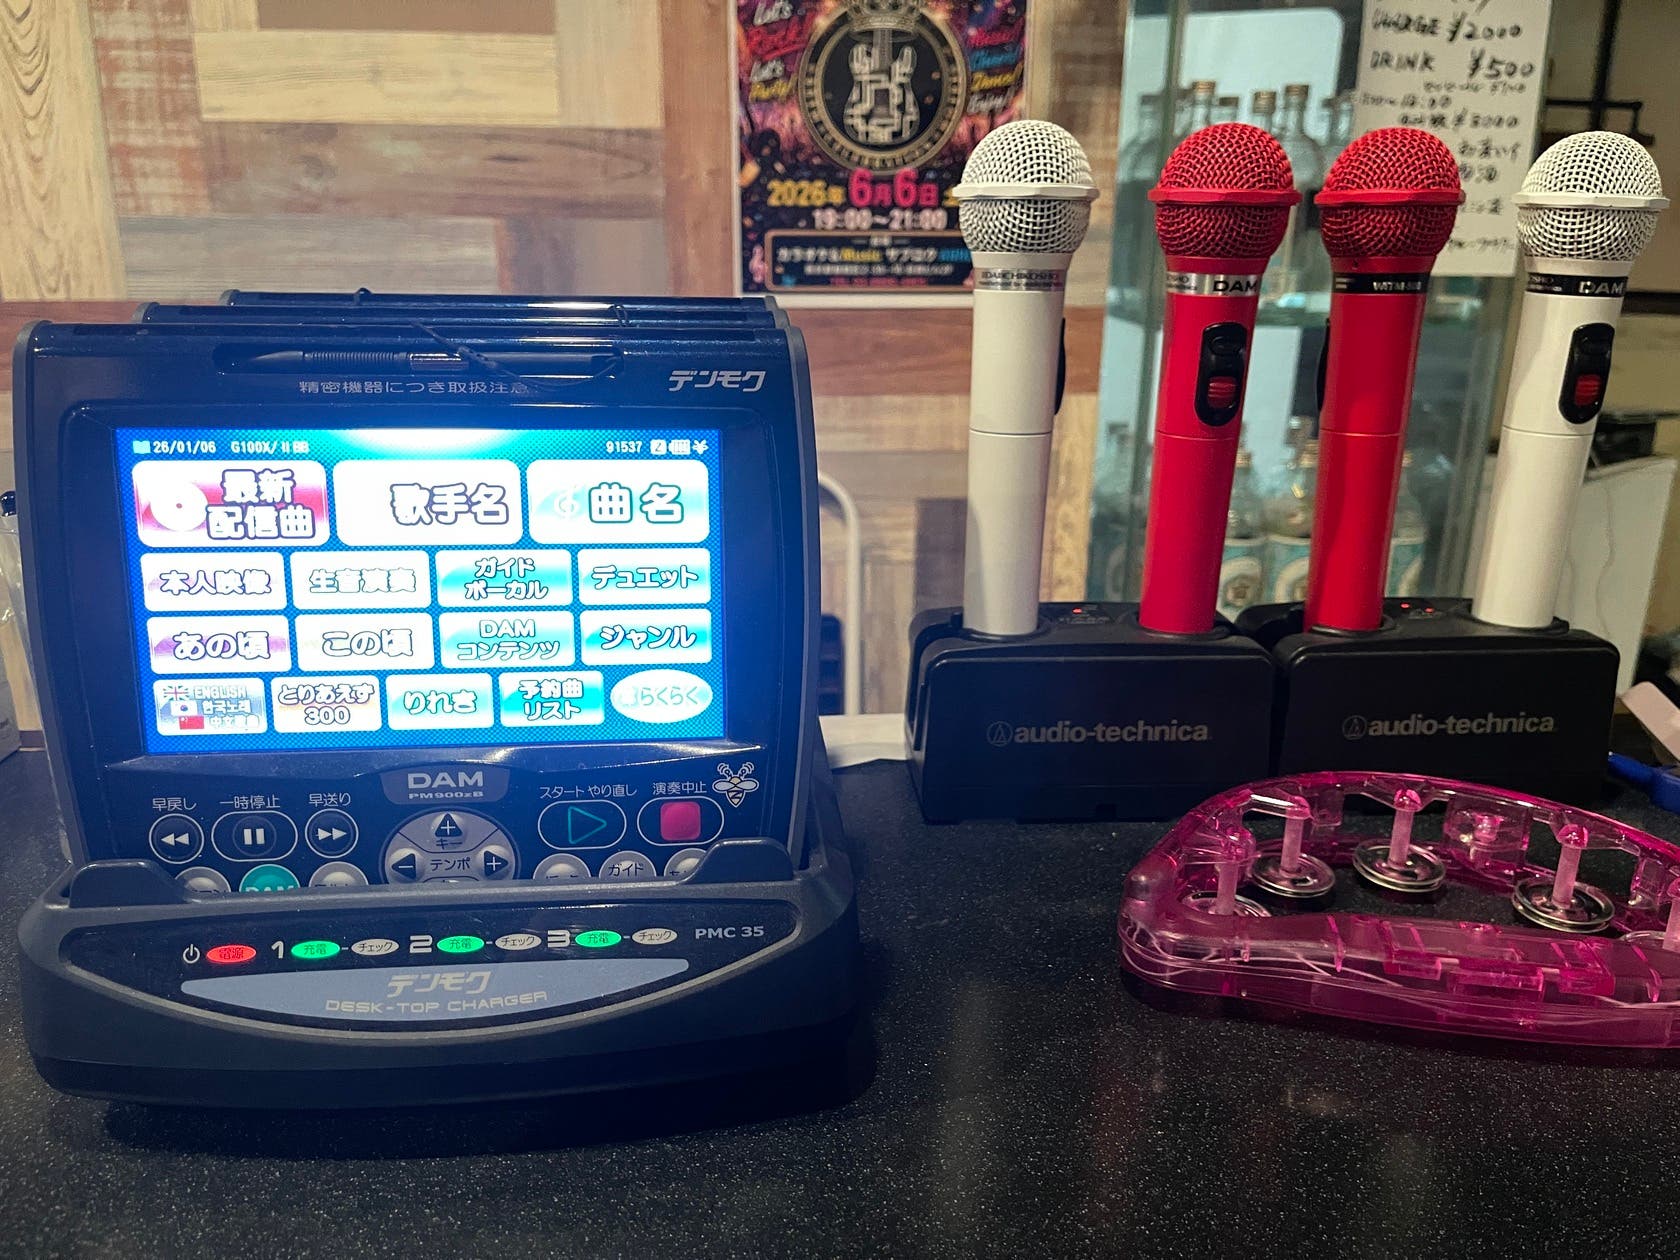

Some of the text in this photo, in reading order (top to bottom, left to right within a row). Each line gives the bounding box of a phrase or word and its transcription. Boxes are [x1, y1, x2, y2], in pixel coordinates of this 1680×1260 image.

[1213, 280, 1257, 292] DAM
[1579, 281, 1624, 294] DAM
[668, 369, 766, 393] デンモク
[153, 440, 217, 454] 26/01/06
[605, 440, 643, 453] 91537
[220, 468, 296, 504] 最新
[205, 503, 316, 540] 配信曲
[474, 556, 535, 579] ガイド
[591, 564, 699, 590] デュエット
[464, 579, 549, 601] ボーカル
[479, 619, 536, 638] DAM
[599, 624, 697, 651] ジャンル
[172, 632, 271, 661] あの頃
[321, 628, 414, 657] この頃
[457, 641, 560, 661] コンテンツ
[193, 685, 248, 700] ENGLISH
[517, 678, 584, 699] 予約曲
[641, 685, 698, 706] らくらく
[403, 688, 478, 714] りれき
[523, 700, 581, 721] リスト
[304, 706, 350, 726] 300
[1368, 712, 1555, 736] audio-technica
[1014, 719, 1209, 743] audio-technica
[407, 771, 484, 789] DAM
[539, 781, 637, 799] スタート やり直し
[652, 780, 708, 796] 演奏中止
[152, 797, 197, 811] 早戻し
[219, 794, 281, 810] 一時停止
[308, 792, 351, 807] 早送り
[436, 837, 463, 850] キー
[430, 857, 471, 872] テンポ
[608, 863, 645, 877] ガイド
[695, 926, 765, 940] PMC 35
[270, 940, 284, 959] 1
[303, 944, 328, 956] 充電
[358, 941, 393, 953] チェック
[409, 935, 433, 953] 2
[450, 939, 475, 951] 充電
[501, 936, 536, 948] チェック
[547, 930, 571, 948] 3
[638, 930, 673, 942] チェック
[387, 971, 491, 999] デンモク
[447, 991, 548, 1013] CHARGER
